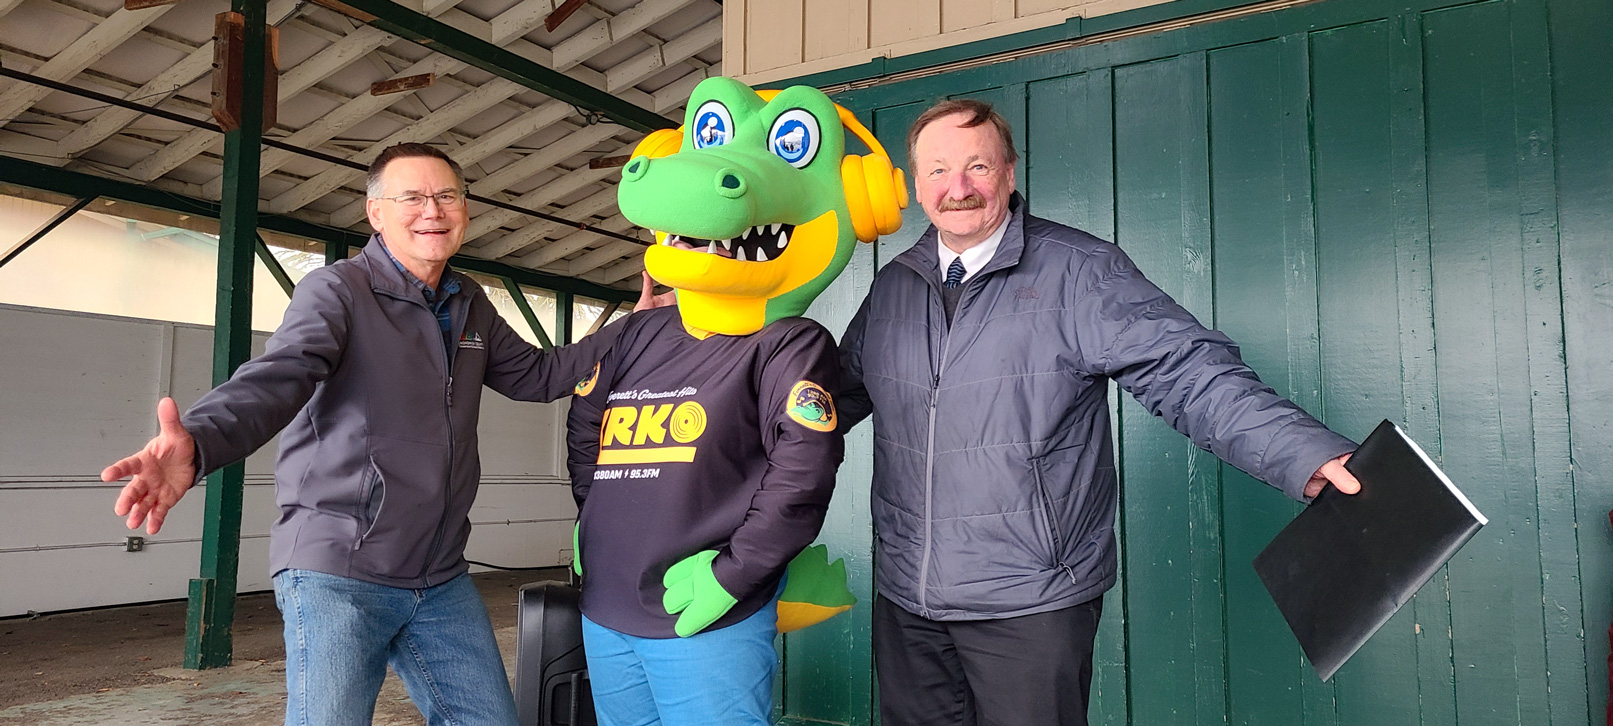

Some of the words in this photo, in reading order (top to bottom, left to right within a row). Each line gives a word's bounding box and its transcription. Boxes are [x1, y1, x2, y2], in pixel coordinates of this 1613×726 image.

[637, 389, 679, 401] Greatest
[676, 386, 697, 398] Hits
[629, 468, 660, 479] 95.3FM
